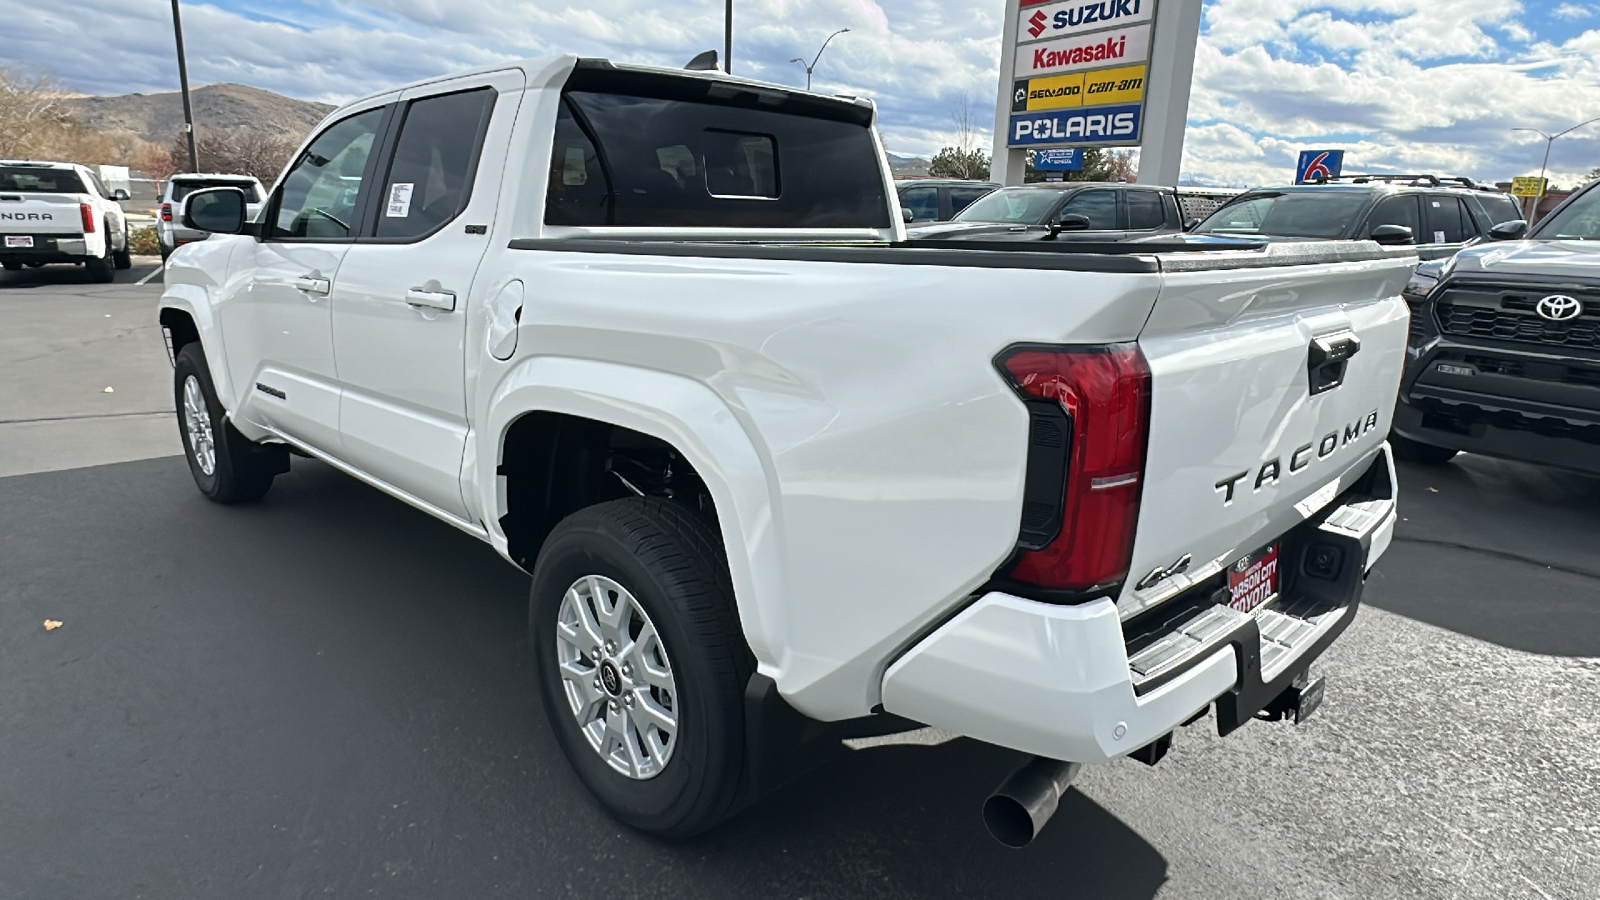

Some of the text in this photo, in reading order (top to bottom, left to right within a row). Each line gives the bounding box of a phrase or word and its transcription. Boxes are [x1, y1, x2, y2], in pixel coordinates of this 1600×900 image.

[1053, 0, 1140, 29] SUZUKI
[1033, 35, 1126, 69] Kawasaki
[1015, 112, 1134, 140] POLARIS
[1303, 151, 1331, 181] 6
[1214, 408, 1378, 507] TACOMA
[1261, 558, 1278, 581] CITY
